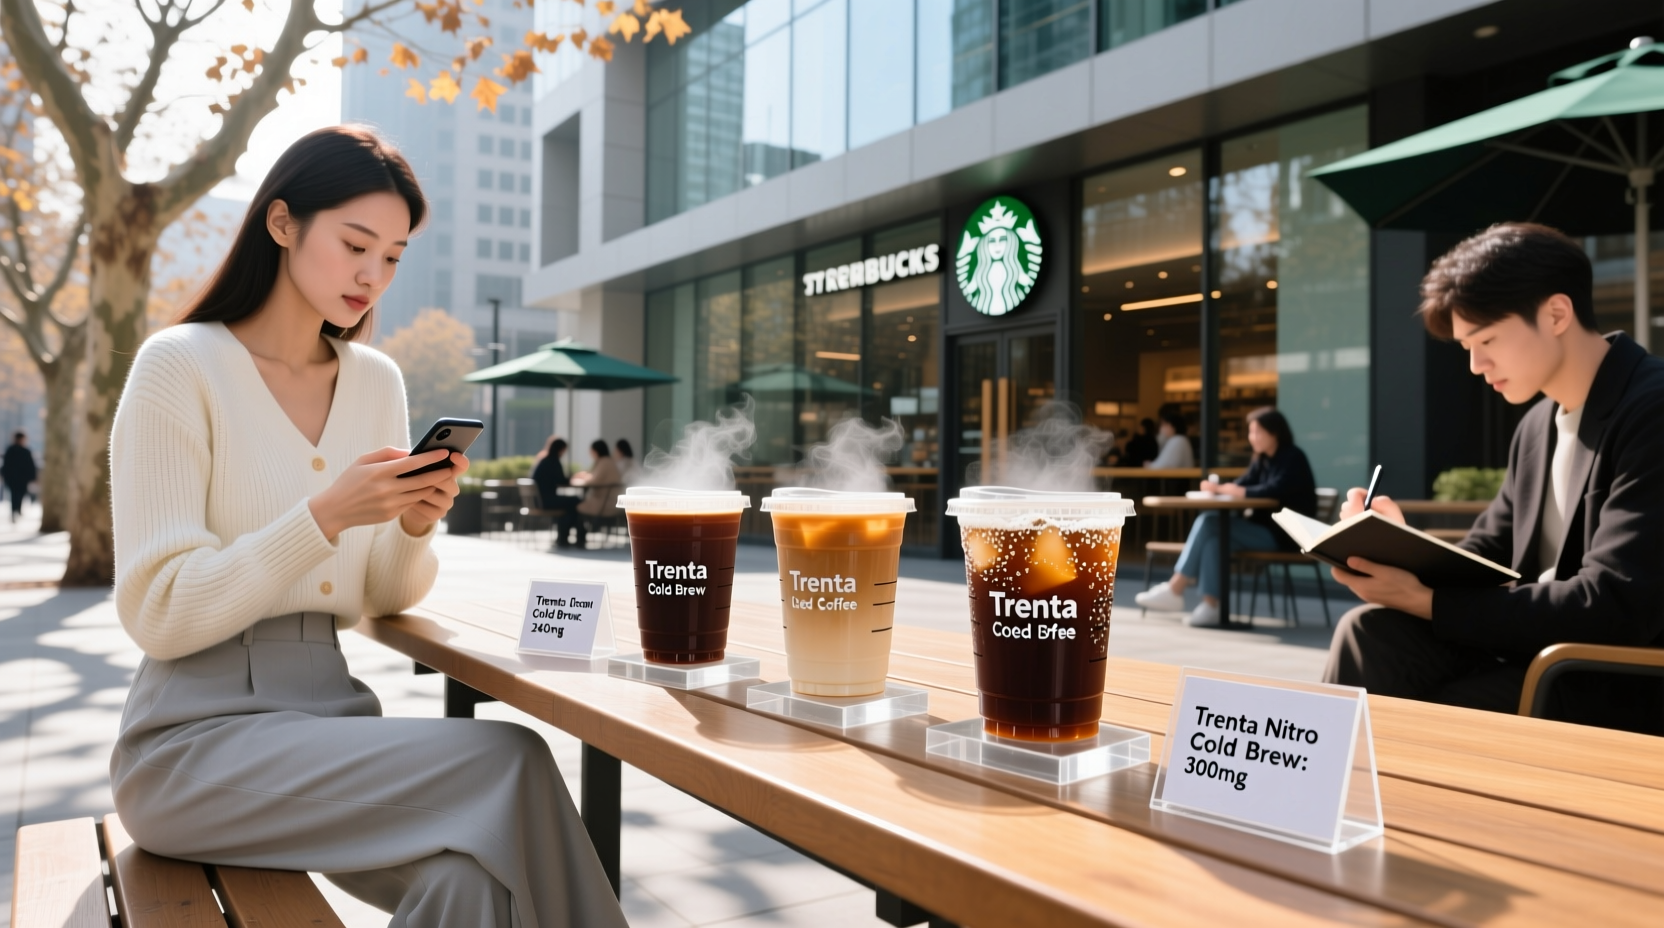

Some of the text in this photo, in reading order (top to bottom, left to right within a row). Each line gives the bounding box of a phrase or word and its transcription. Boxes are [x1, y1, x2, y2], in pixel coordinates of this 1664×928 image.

[646, 559, 707, 580] Trenta
[648, 583, 706, 596] Cold Brew
[789, 570, 856, 593] Trenta
[532, 608, 555, 619] Cold
[989, 590, 1078, 619] Trenta
[992, 621, 1032, 639] Coed
[1195, 705, 1319, 745] Trenta Nitro
[1190, 732, 1308, 771] Cold Brew:
[1184, 756, 1248, 791] 300mg
